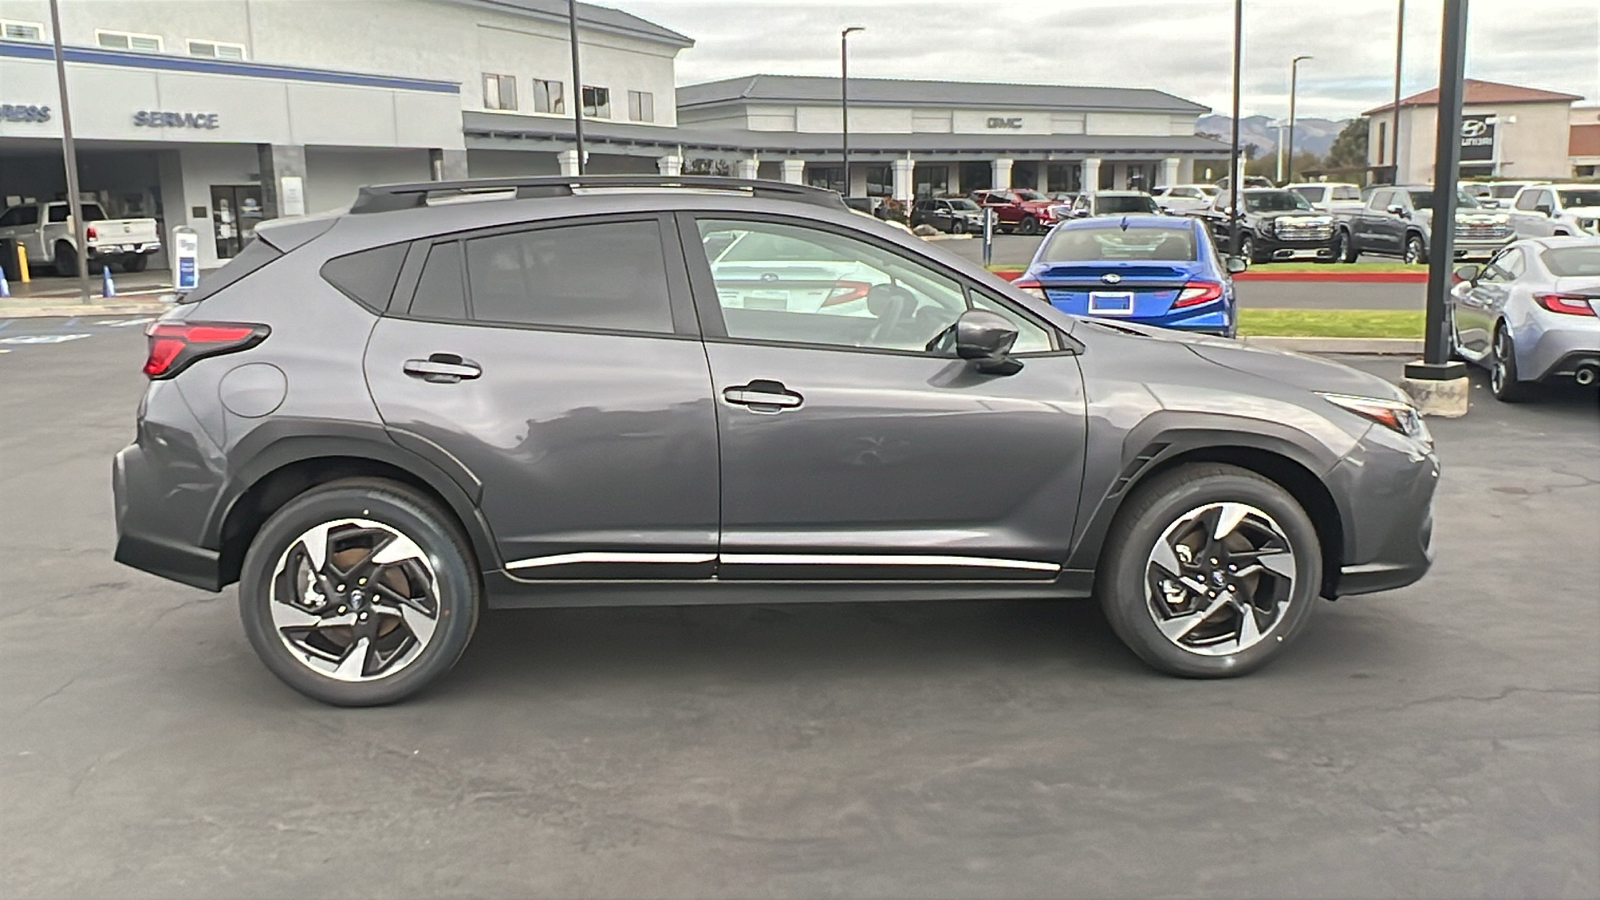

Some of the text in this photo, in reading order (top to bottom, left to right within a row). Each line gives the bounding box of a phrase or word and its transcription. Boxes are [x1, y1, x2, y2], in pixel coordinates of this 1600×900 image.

[0, 104, 51, 123] RESS
[133, 111, 219, 130] SERVICE
[986, 117, 1022, 129] GMC
[1461, 137, 1493, 147] UNDAI
